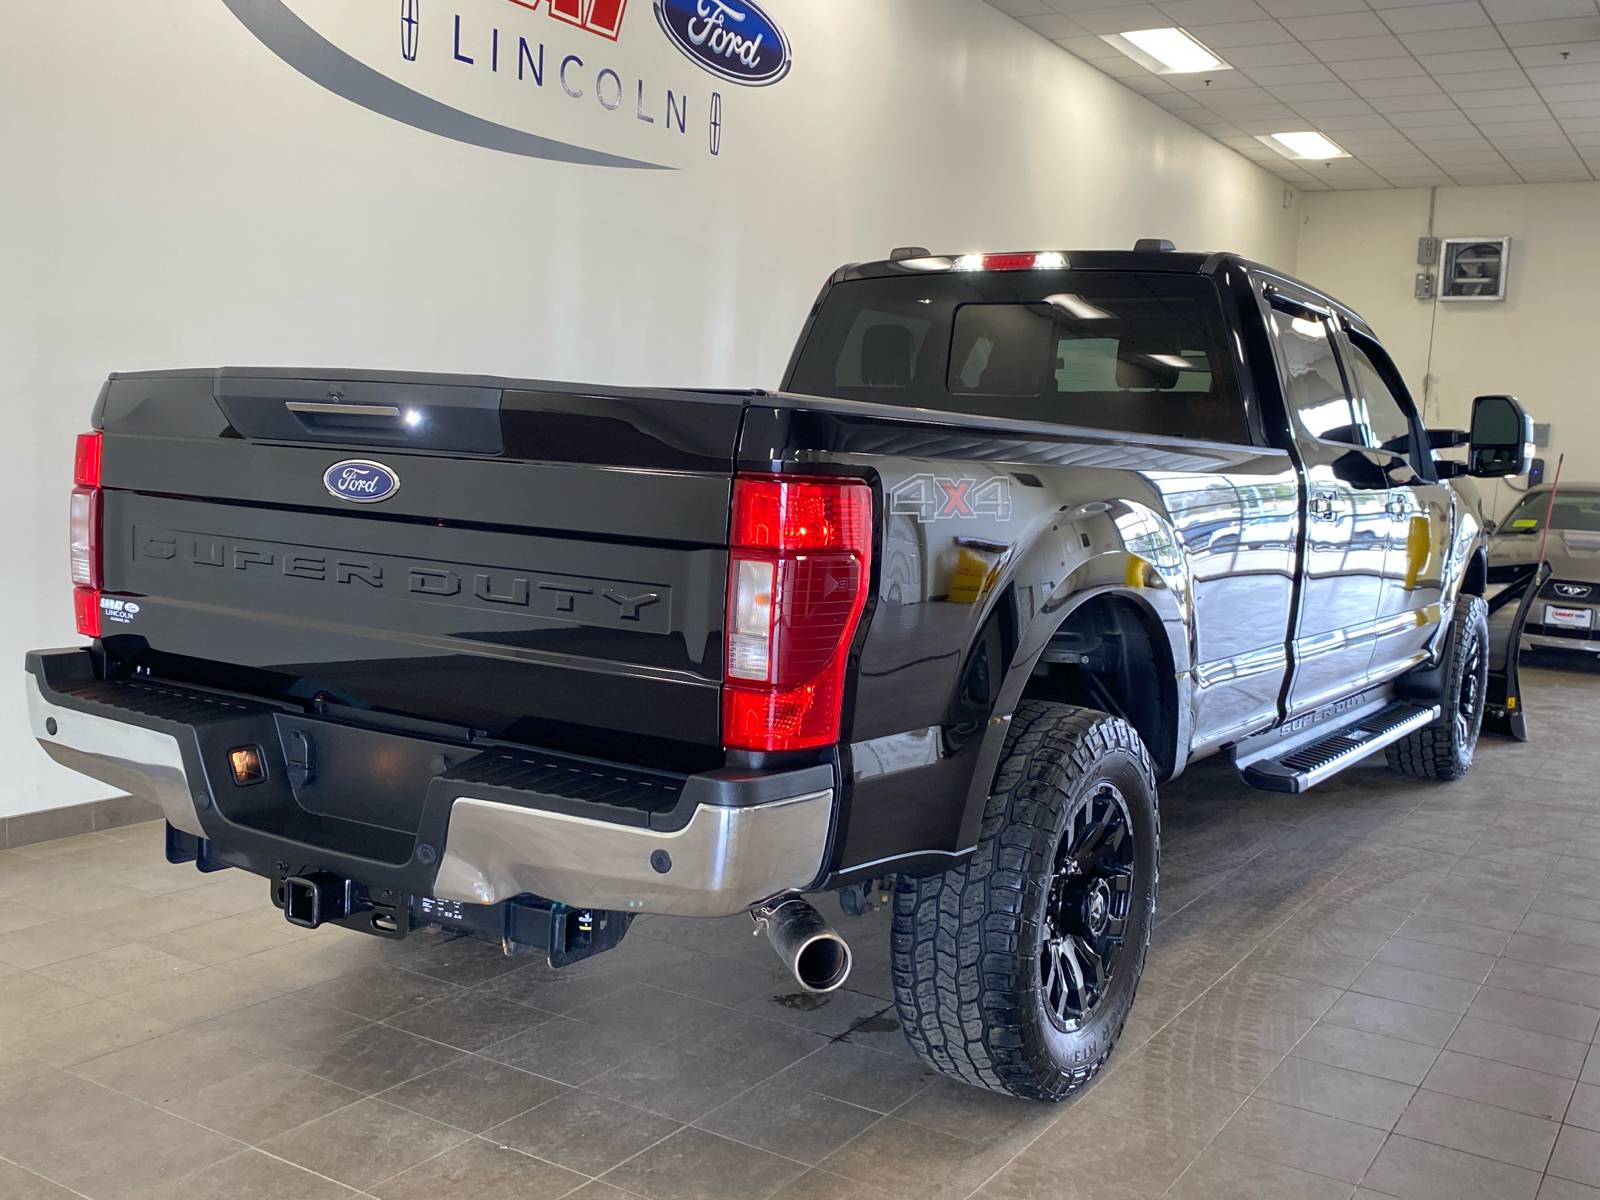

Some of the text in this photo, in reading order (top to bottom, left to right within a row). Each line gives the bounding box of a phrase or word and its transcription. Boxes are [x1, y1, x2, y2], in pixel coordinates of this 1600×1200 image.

[687, 0, 763, 69] Ford
[453, 13, 687, 134] LINCOLN
[337, 467, 380, 493] Ford
[140, 531, 660, 622] SUPER DUTY
[105, 609, 134, 619] LINCOLN
[1280, 690, 1368, 737] SUPER DUTY
